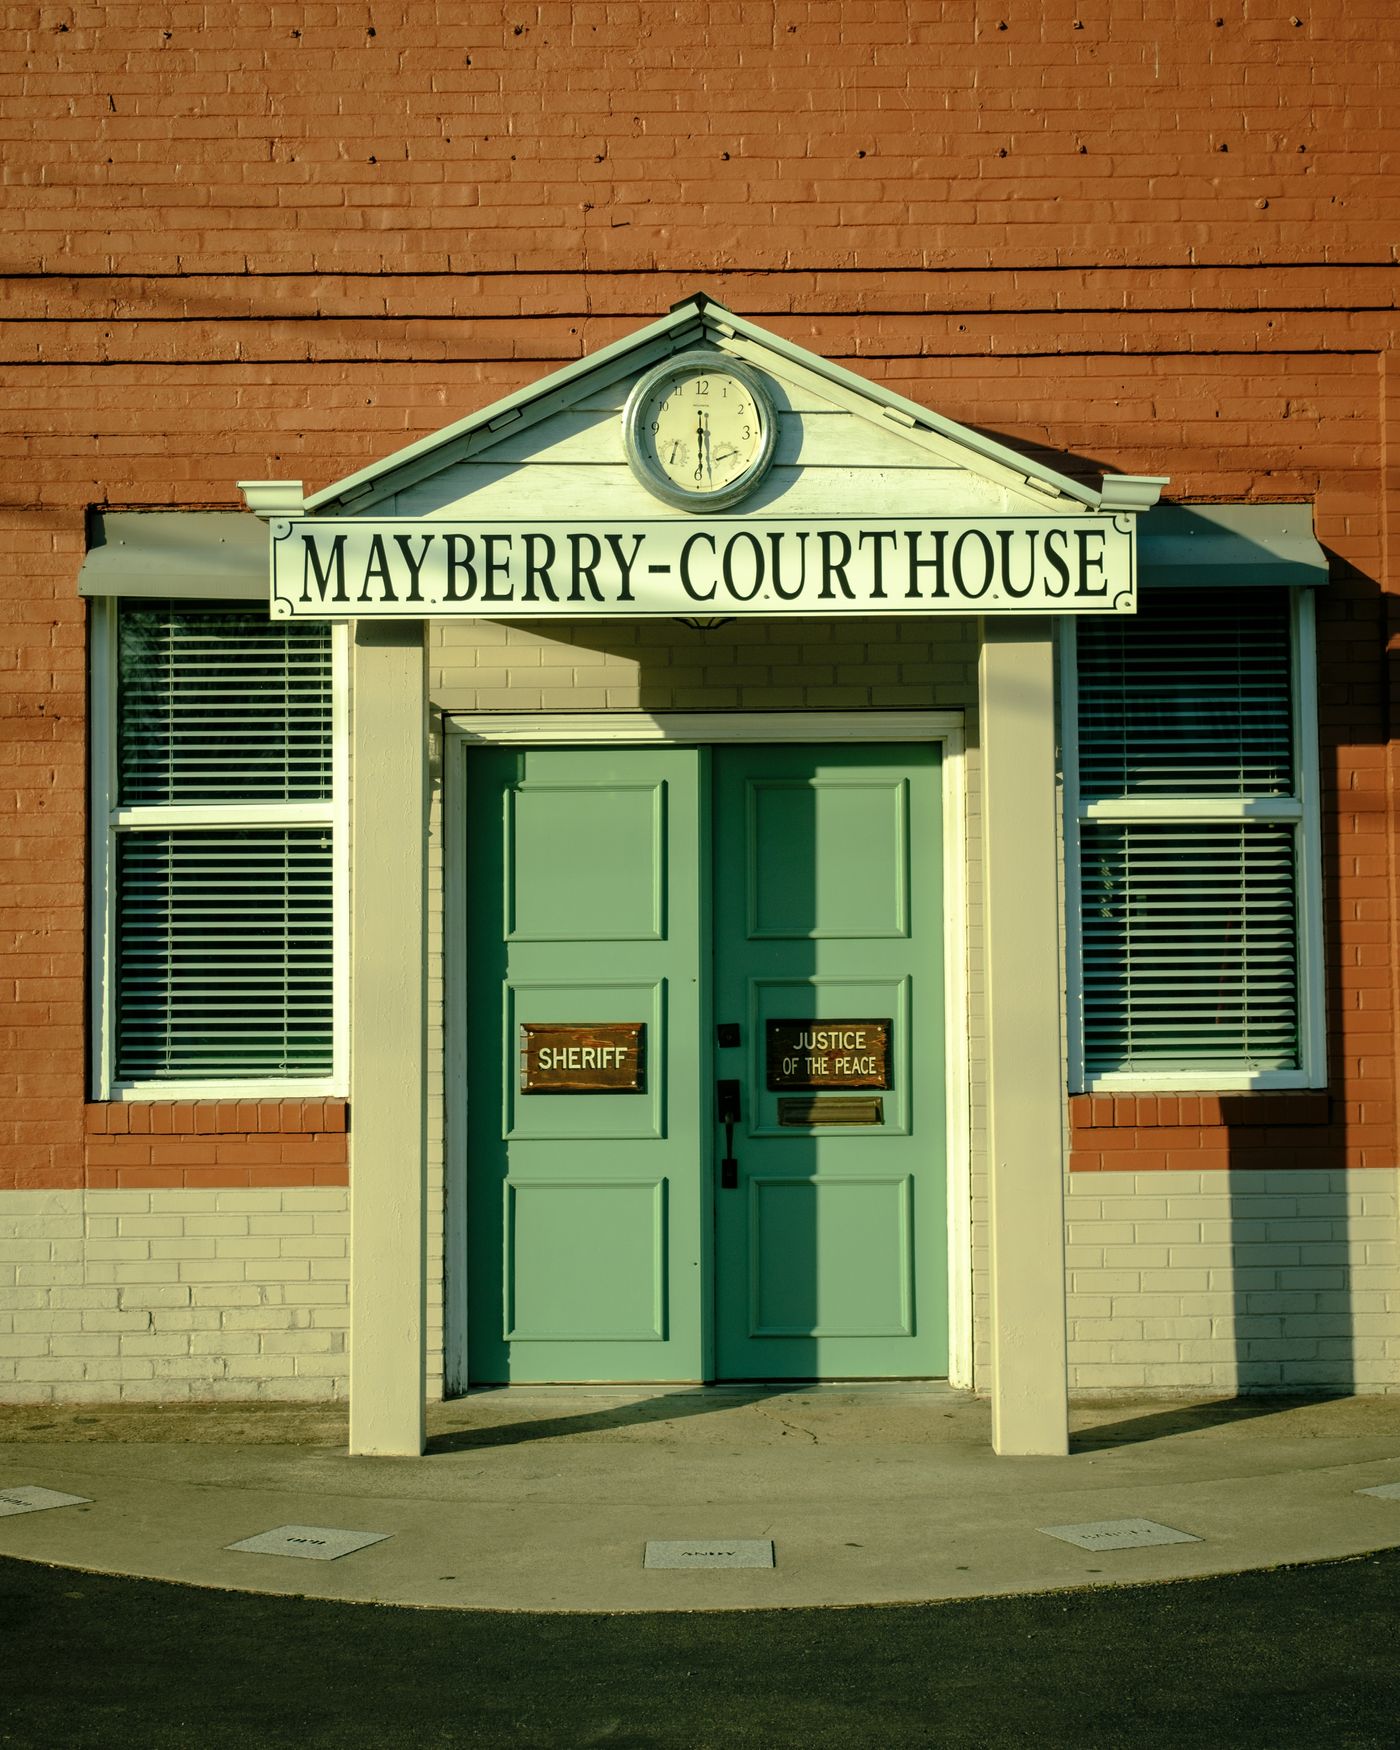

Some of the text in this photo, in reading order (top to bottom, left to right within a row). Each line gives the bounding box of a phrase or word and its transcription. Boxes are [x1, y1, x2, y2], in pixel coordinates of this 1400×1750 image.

[674, 386, 683, 396] 11
[695, 380, 709, 395] 12
[722, 387, 727, 398] 1
[658, 401, 669, 411] 10
[737, 404, 744, 415] 2
[651, 422, 660, 436] 9
[742, 425, 750, 440] 3
[694, 467, 703, 481] 6
[299, 529, 1108, 603] MAYBERRY-COURTHOUSE
[793, 1031, 866, 1051] JUSTICE
[538, 1047, 628, 1070] SHERIFF
[782, 1056, 877, 1075] OF THE PEACE
